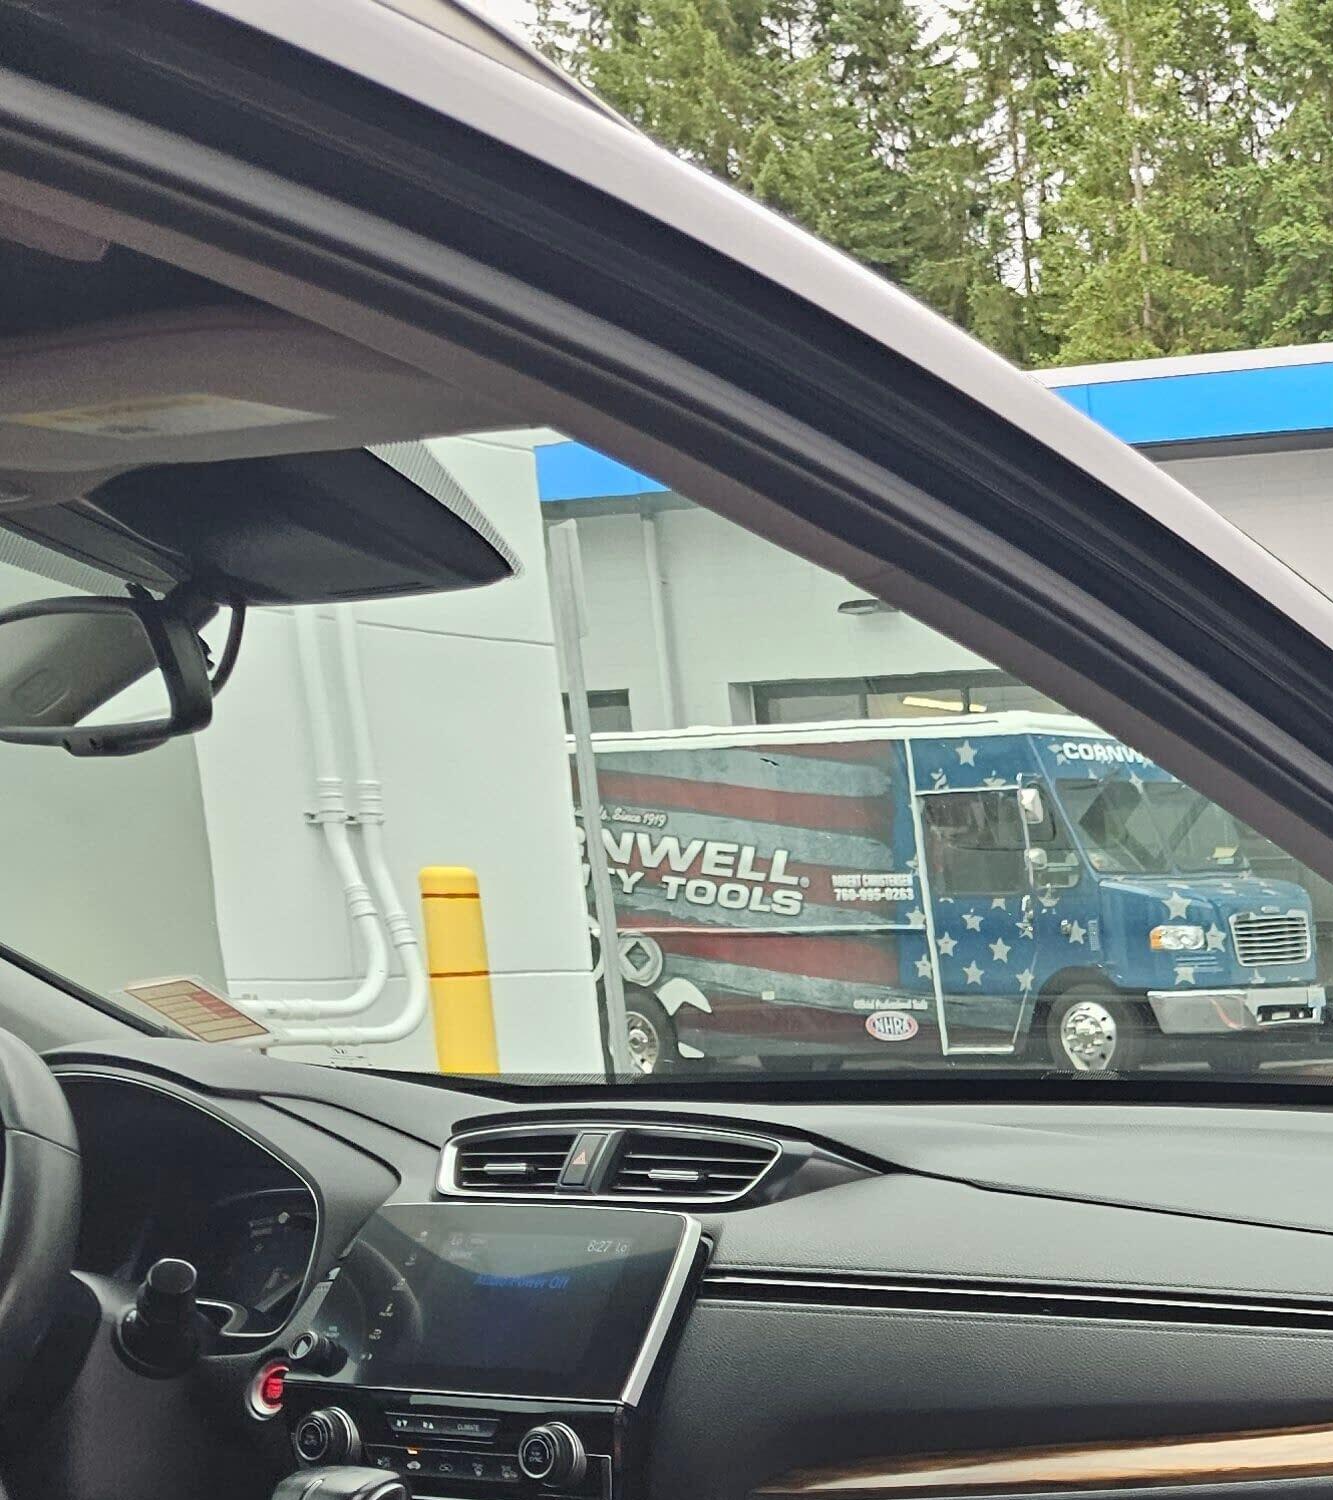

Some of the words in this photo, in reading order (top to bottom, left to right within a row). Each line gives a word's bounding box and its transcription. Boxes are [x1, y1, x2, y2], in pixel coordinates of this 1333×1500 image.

[1062, 742, 1146, 764] CORNW
[642, 812, 668, 828] 1919
[576, 826, 799, 886] NWELL
[660, 875, 804, 916] TOOLS
[587, 1239, 613, 1253] 8:27
